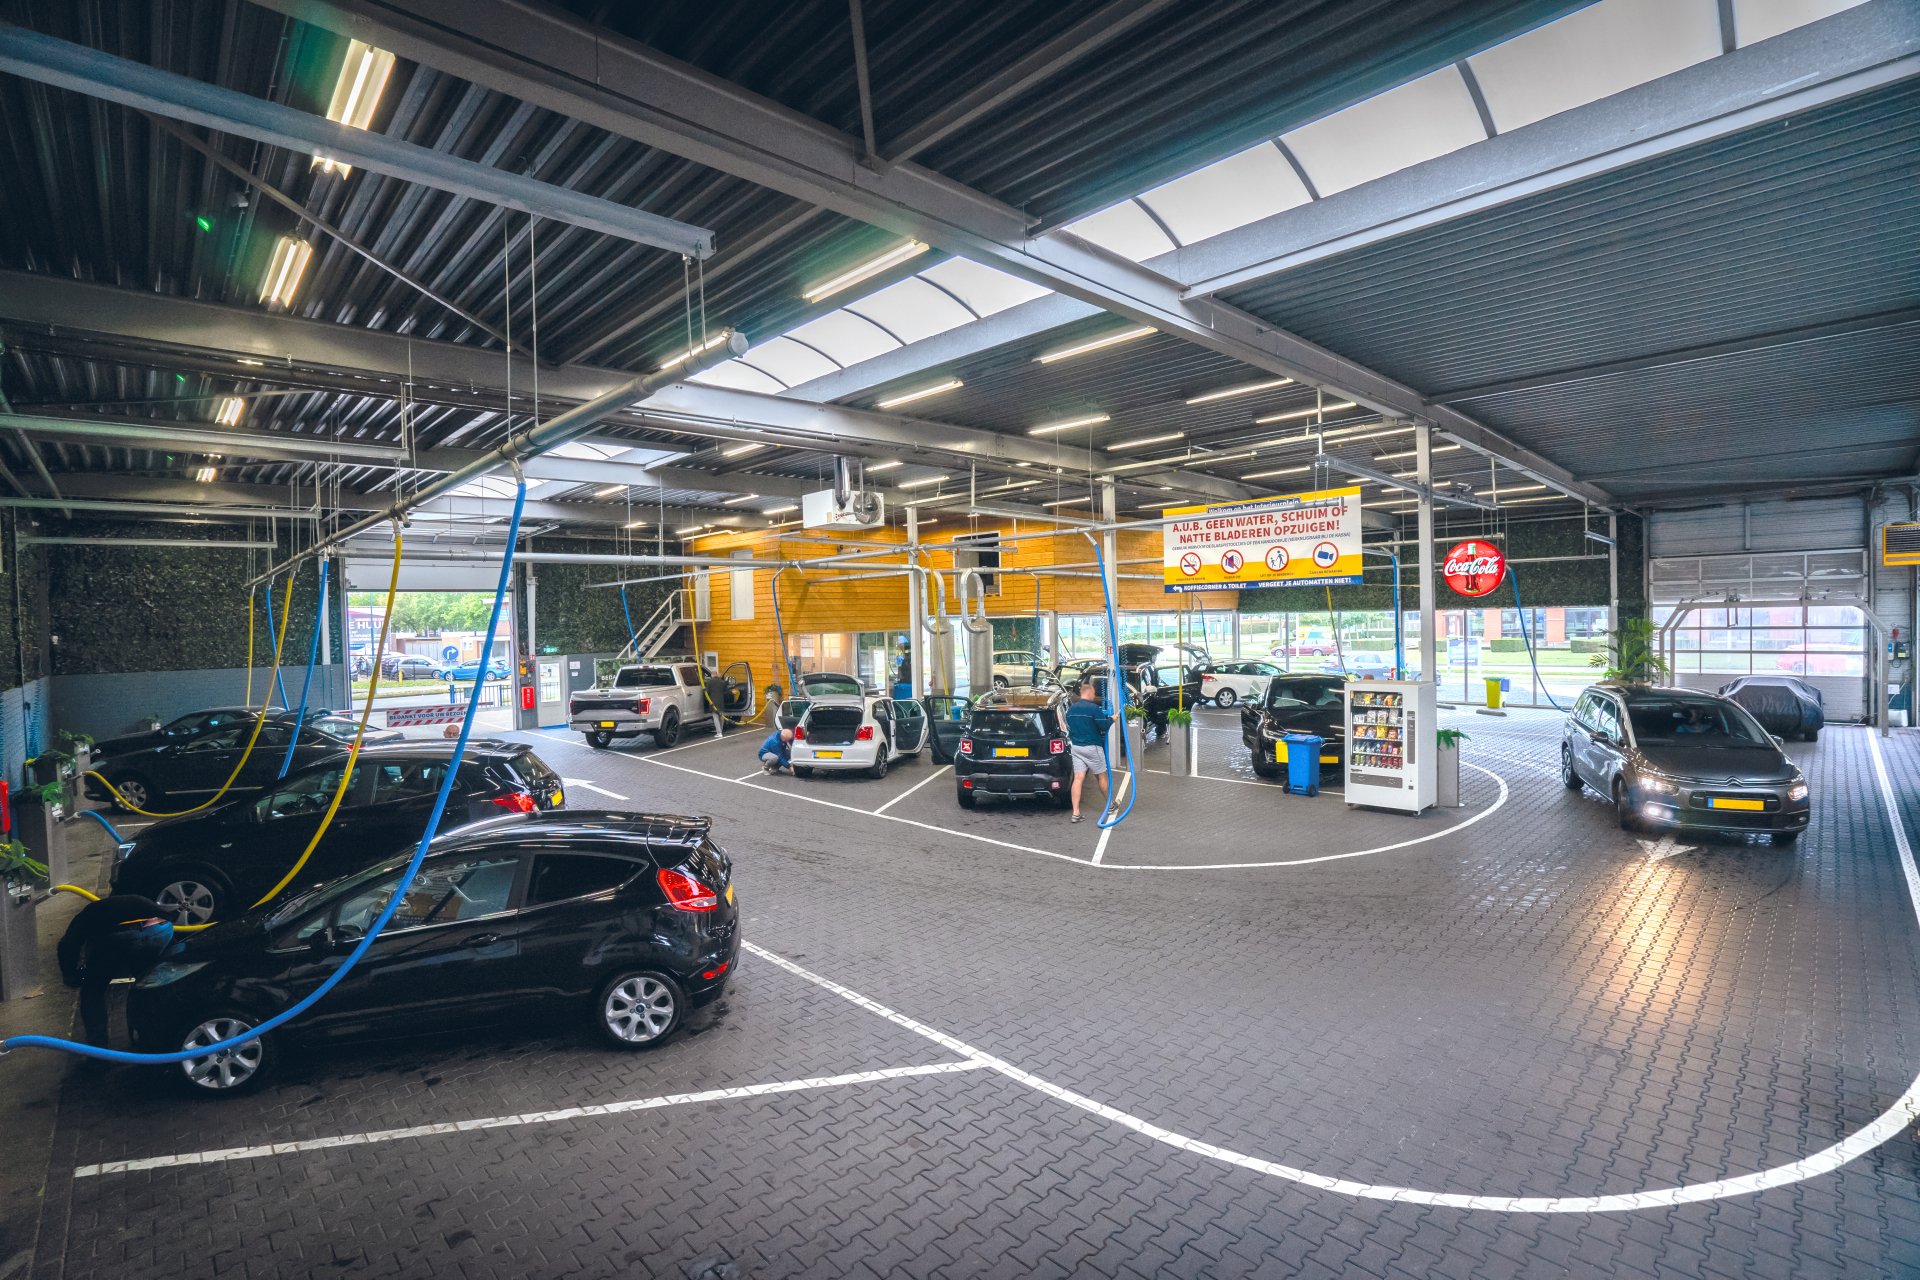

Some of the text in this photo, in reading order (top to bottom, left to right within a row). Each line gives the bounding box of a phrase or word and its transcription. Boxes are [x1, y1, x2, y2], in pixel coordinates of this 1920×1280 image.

[1172, 506, 1348, 532] A.U.B. GEEN WATER, SCHUIM OF
[1180, 520, 1340, 544] NATTE BLADEREN OPZUIGEN!
[1444, 556, 1500, 576] Coca-Cola
